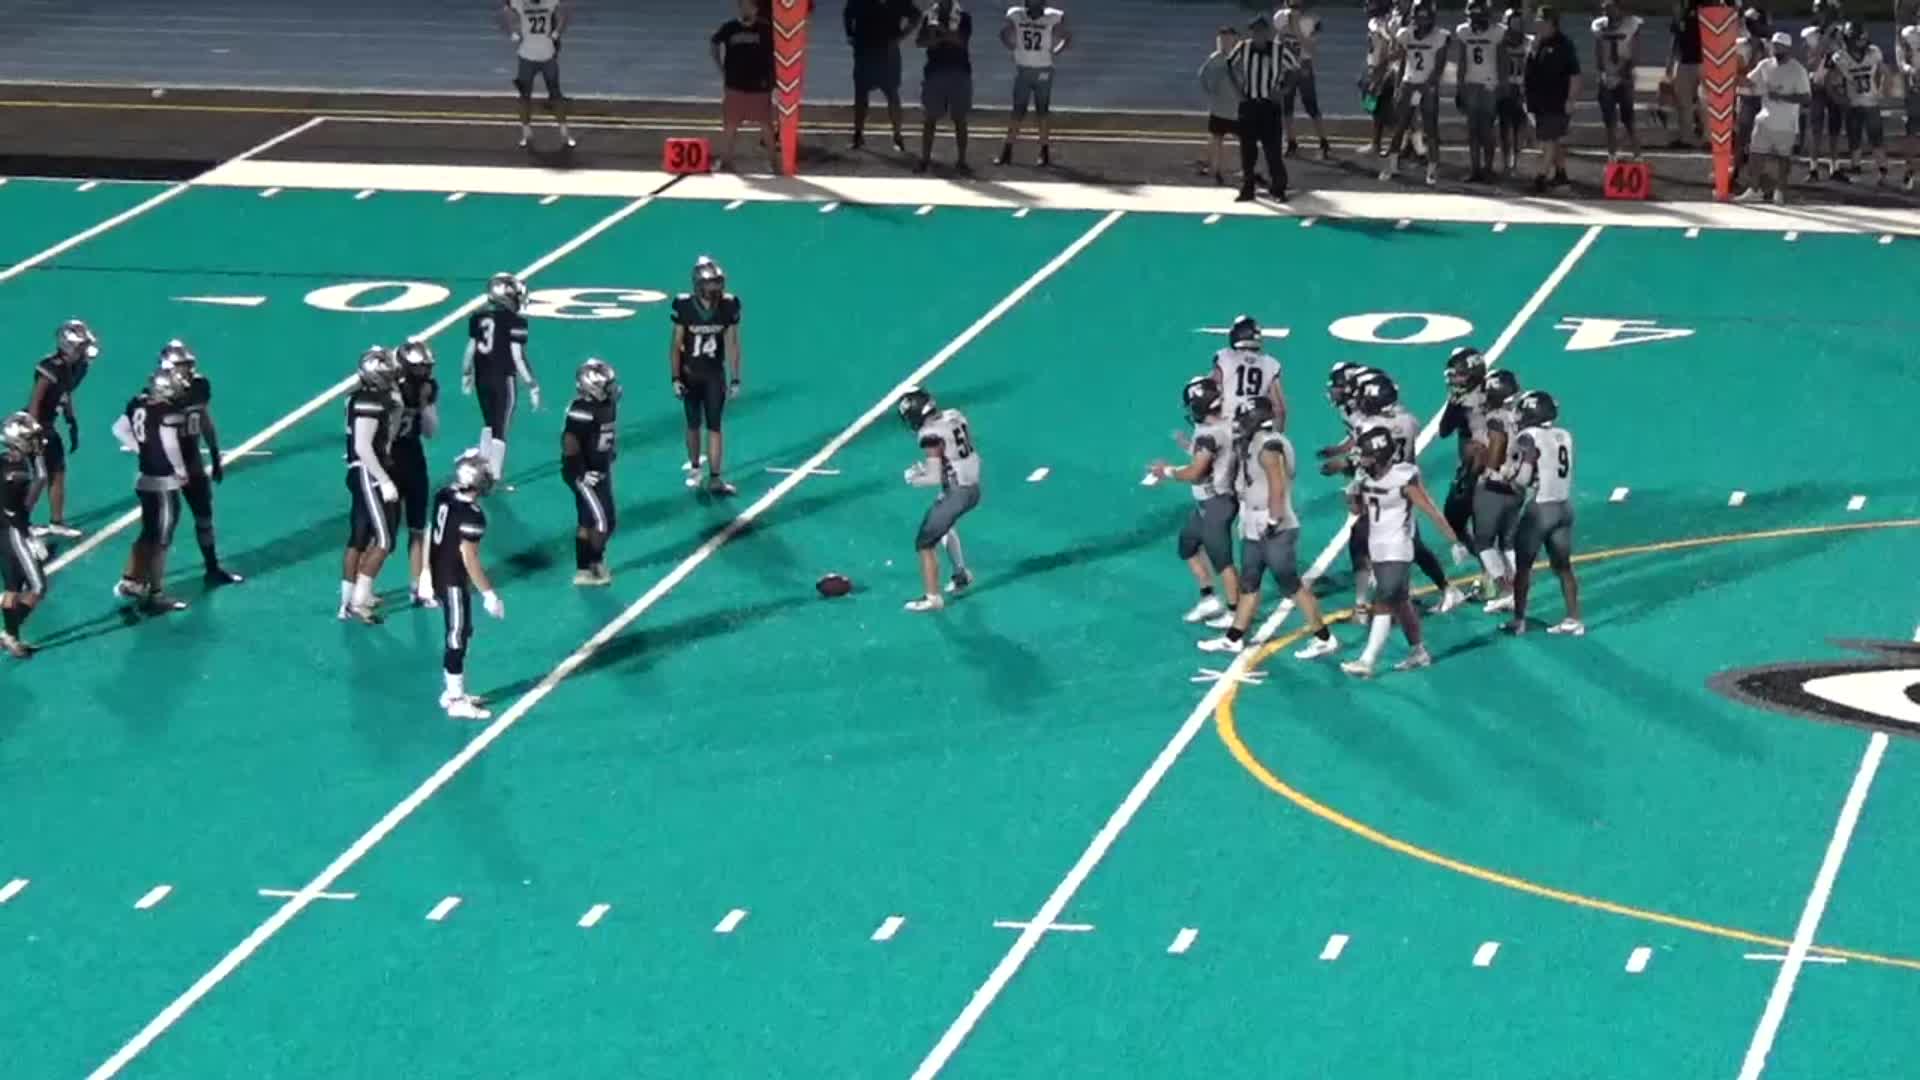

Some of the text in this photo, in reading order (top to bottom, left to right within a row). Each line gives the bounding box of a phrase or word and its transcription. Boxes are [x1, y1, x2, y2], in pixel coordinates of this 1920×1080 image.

[528, 15, 546, 34] 22
[1023, 31, 1042, 51] 52
[1414, 51, 1424, 71] 2
[1473, 46, 1483, 65] 6
[669, 141, 701, 167] 30
[1609, 168, 1642, 193] 40
[477, 317, 495, 354] 3
[691, 335, 717, 357] 14
[1235, 364, 1262, 396] 19
[133, 407, 147, 443] 8
[1558, 444, 1569, 478] 9
[434, 503, 449, 545] 9
